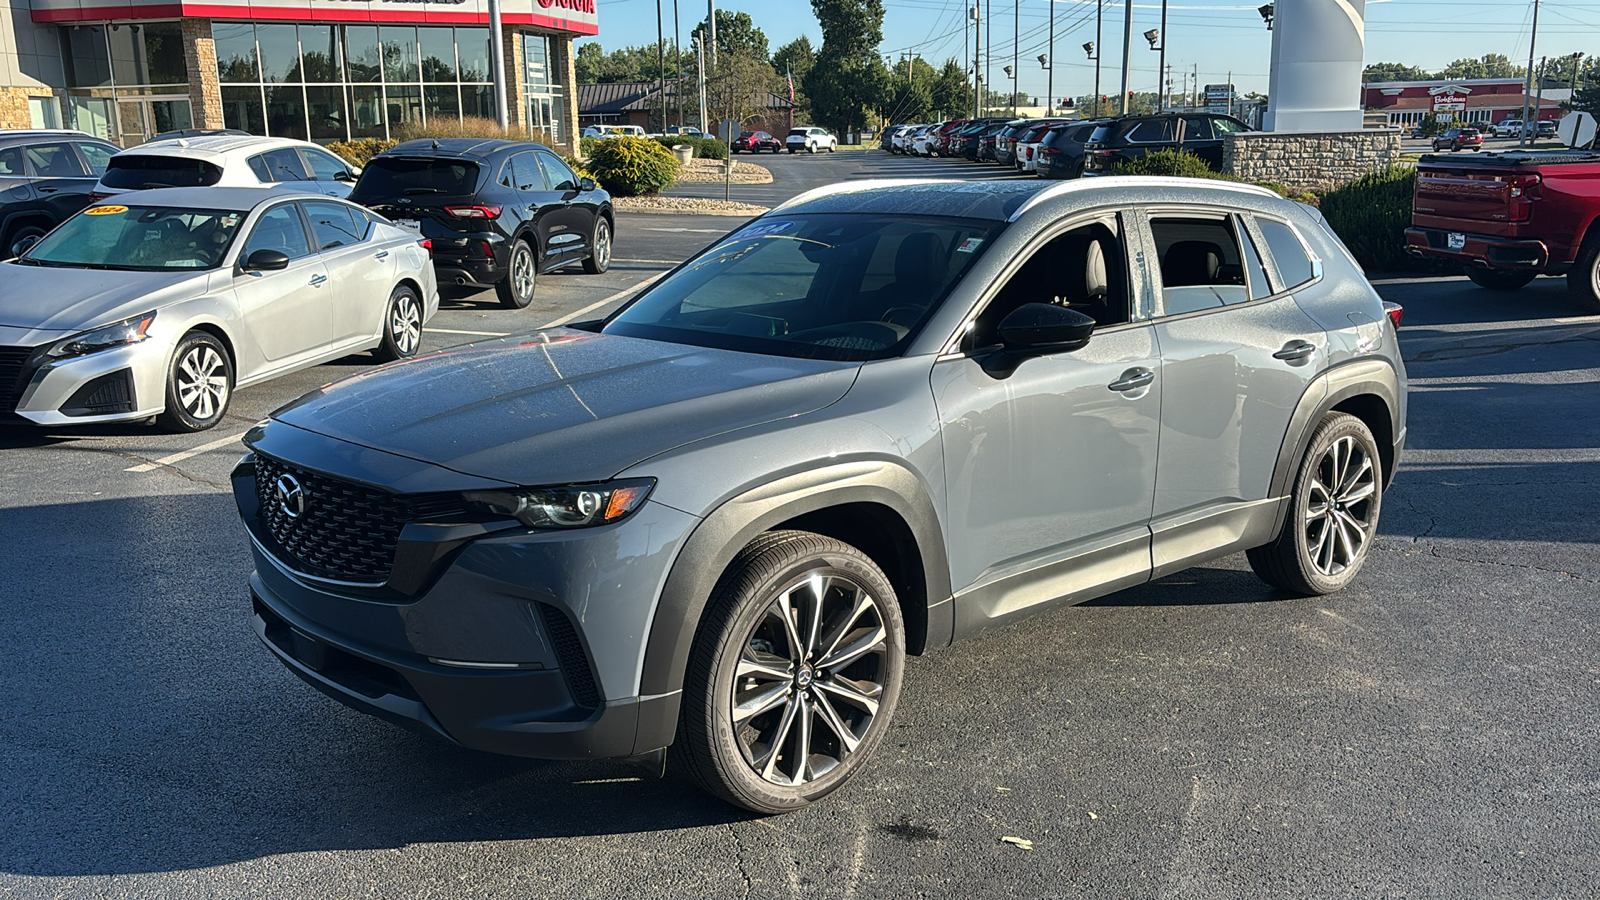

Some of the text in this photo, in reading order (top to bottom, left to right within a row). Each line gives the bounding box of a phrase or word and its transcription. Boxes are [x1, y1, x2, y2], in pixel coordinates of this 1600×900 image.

[1434, 95, 1466, 104] Bob Evans
[844, 561, 900, 629] GOODYEAR
